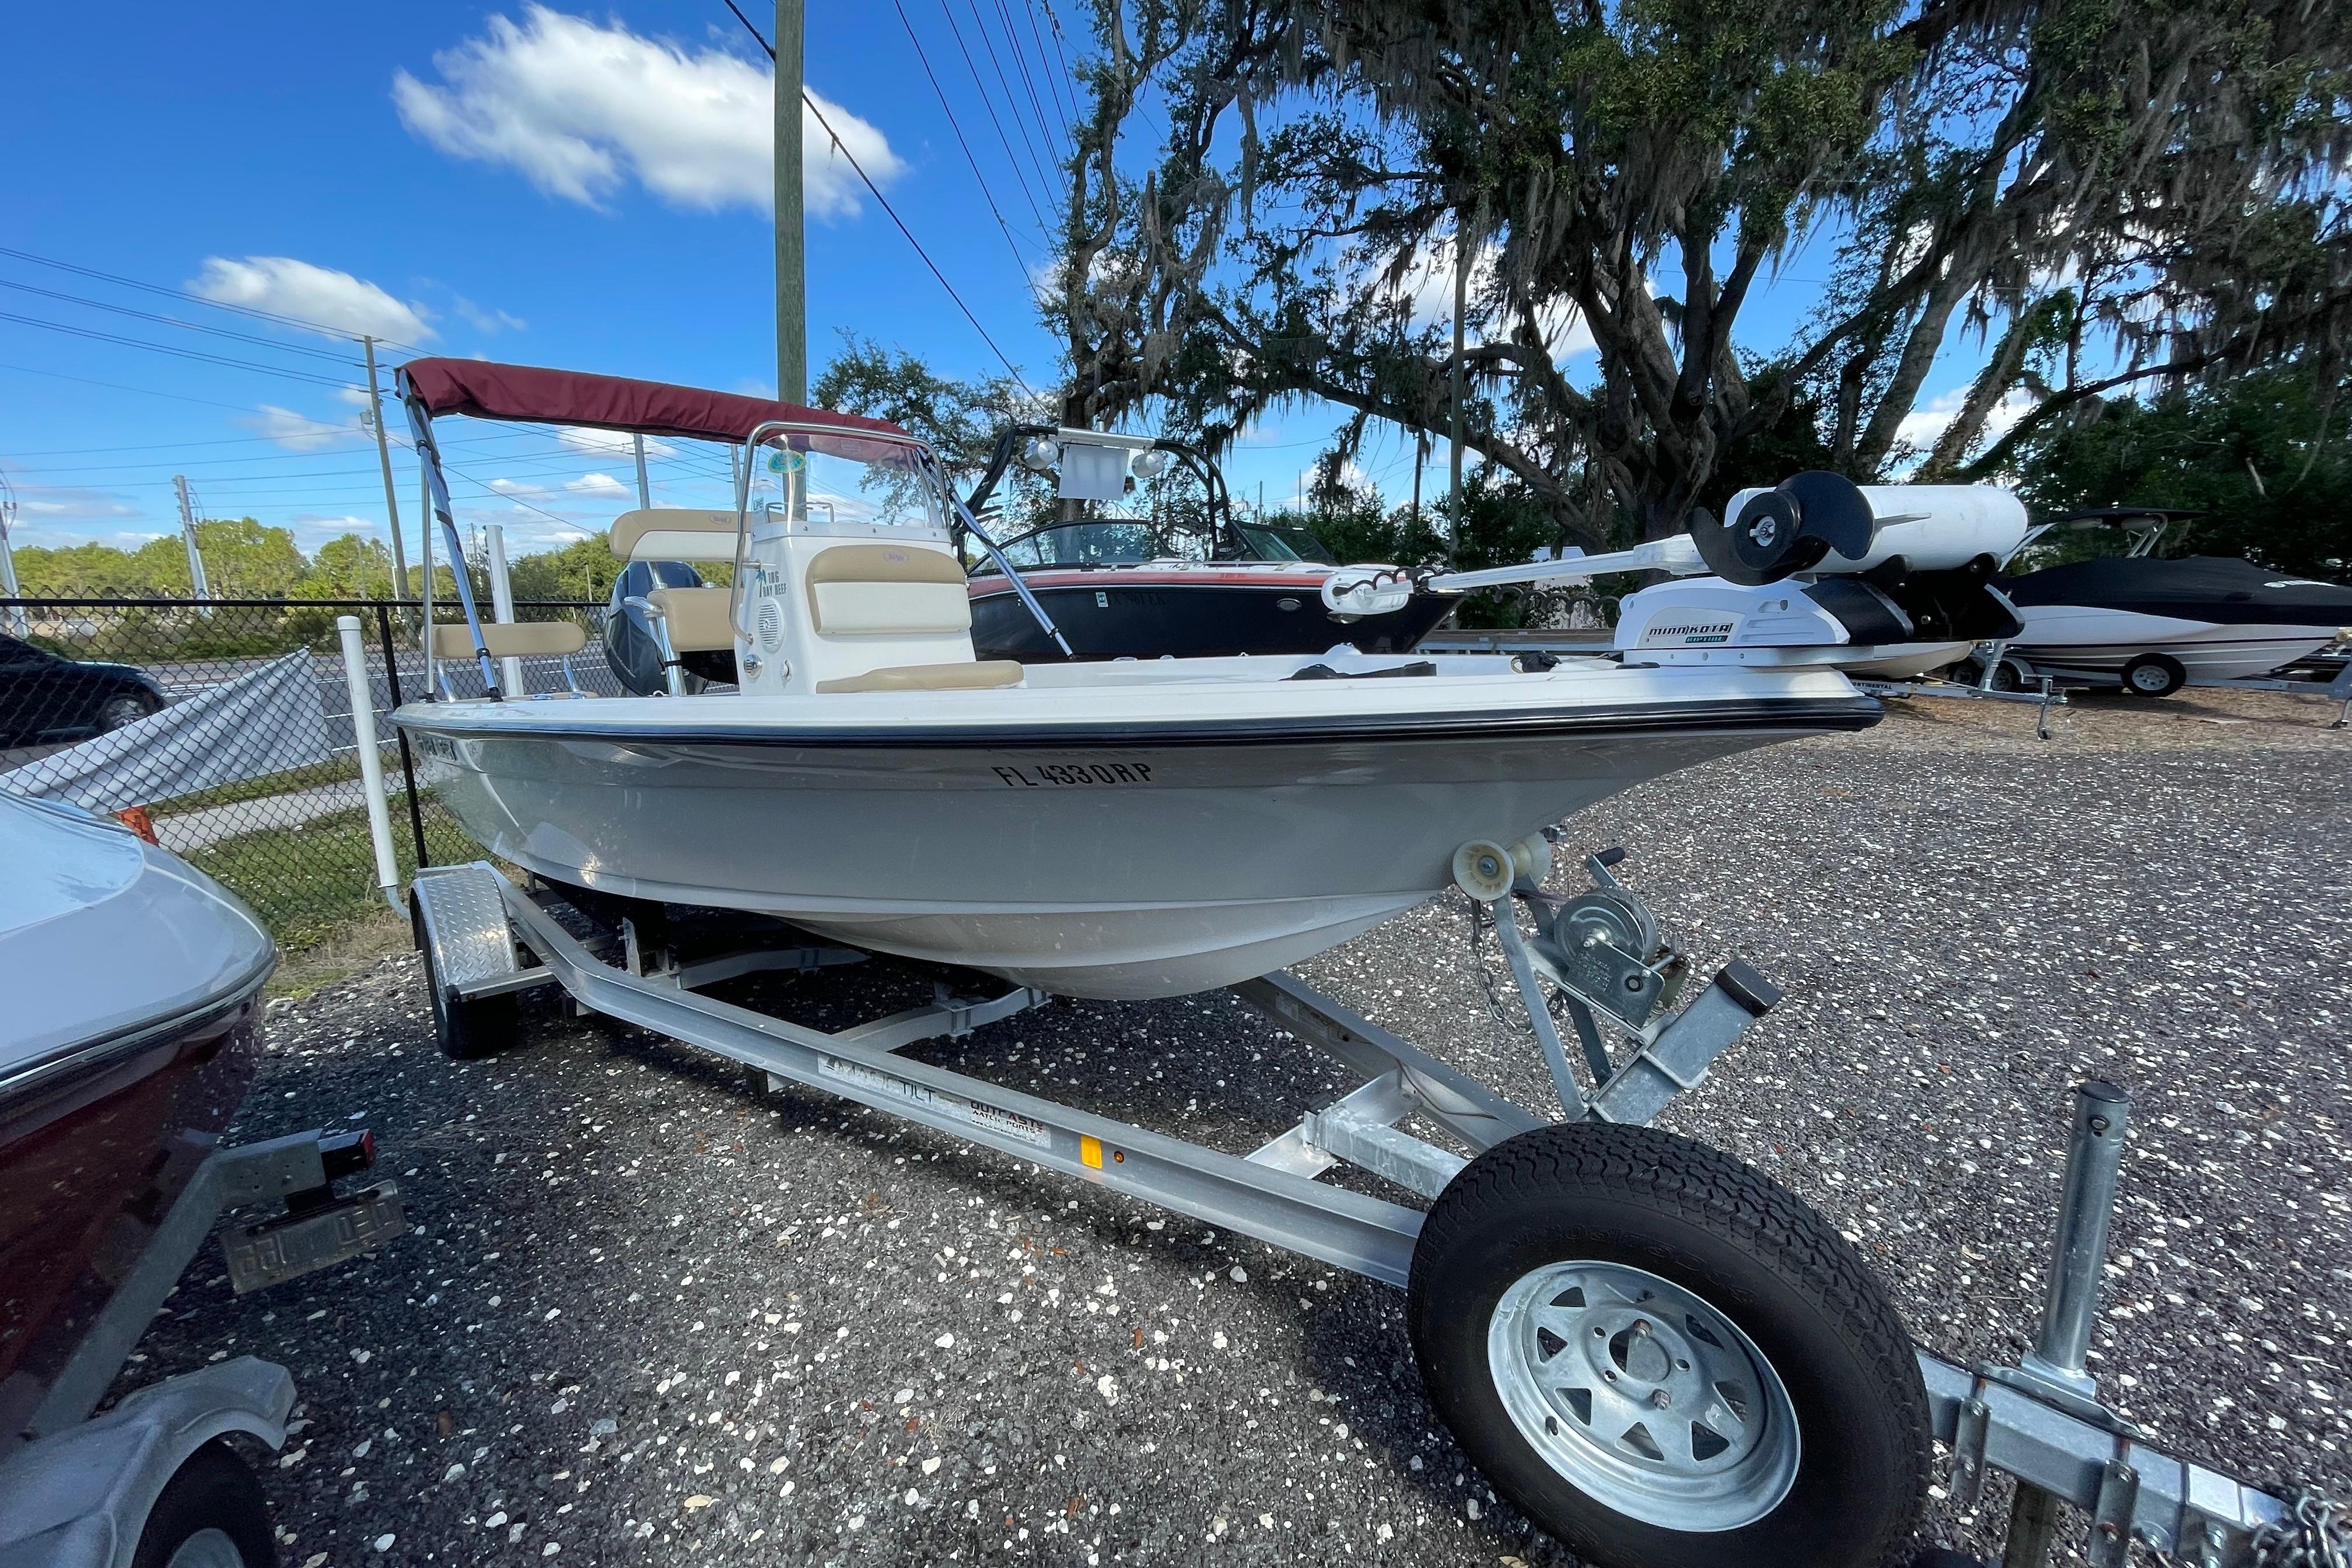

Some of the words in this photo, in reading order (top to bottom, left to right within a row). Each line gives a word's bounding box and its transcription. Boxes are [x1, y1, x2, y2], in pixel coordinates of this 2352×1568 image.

[768, 570, 779, 583] 186
[763, 585, 772, 597] BAY
[775, 583, 786, 595] REEF
[1649, 625, 1688, 635] MINN
[1689, 623, 1733, 634] KOTA
[991, 766, 1039, 786] FL
[898, 1080, 936, 1102] TILT
